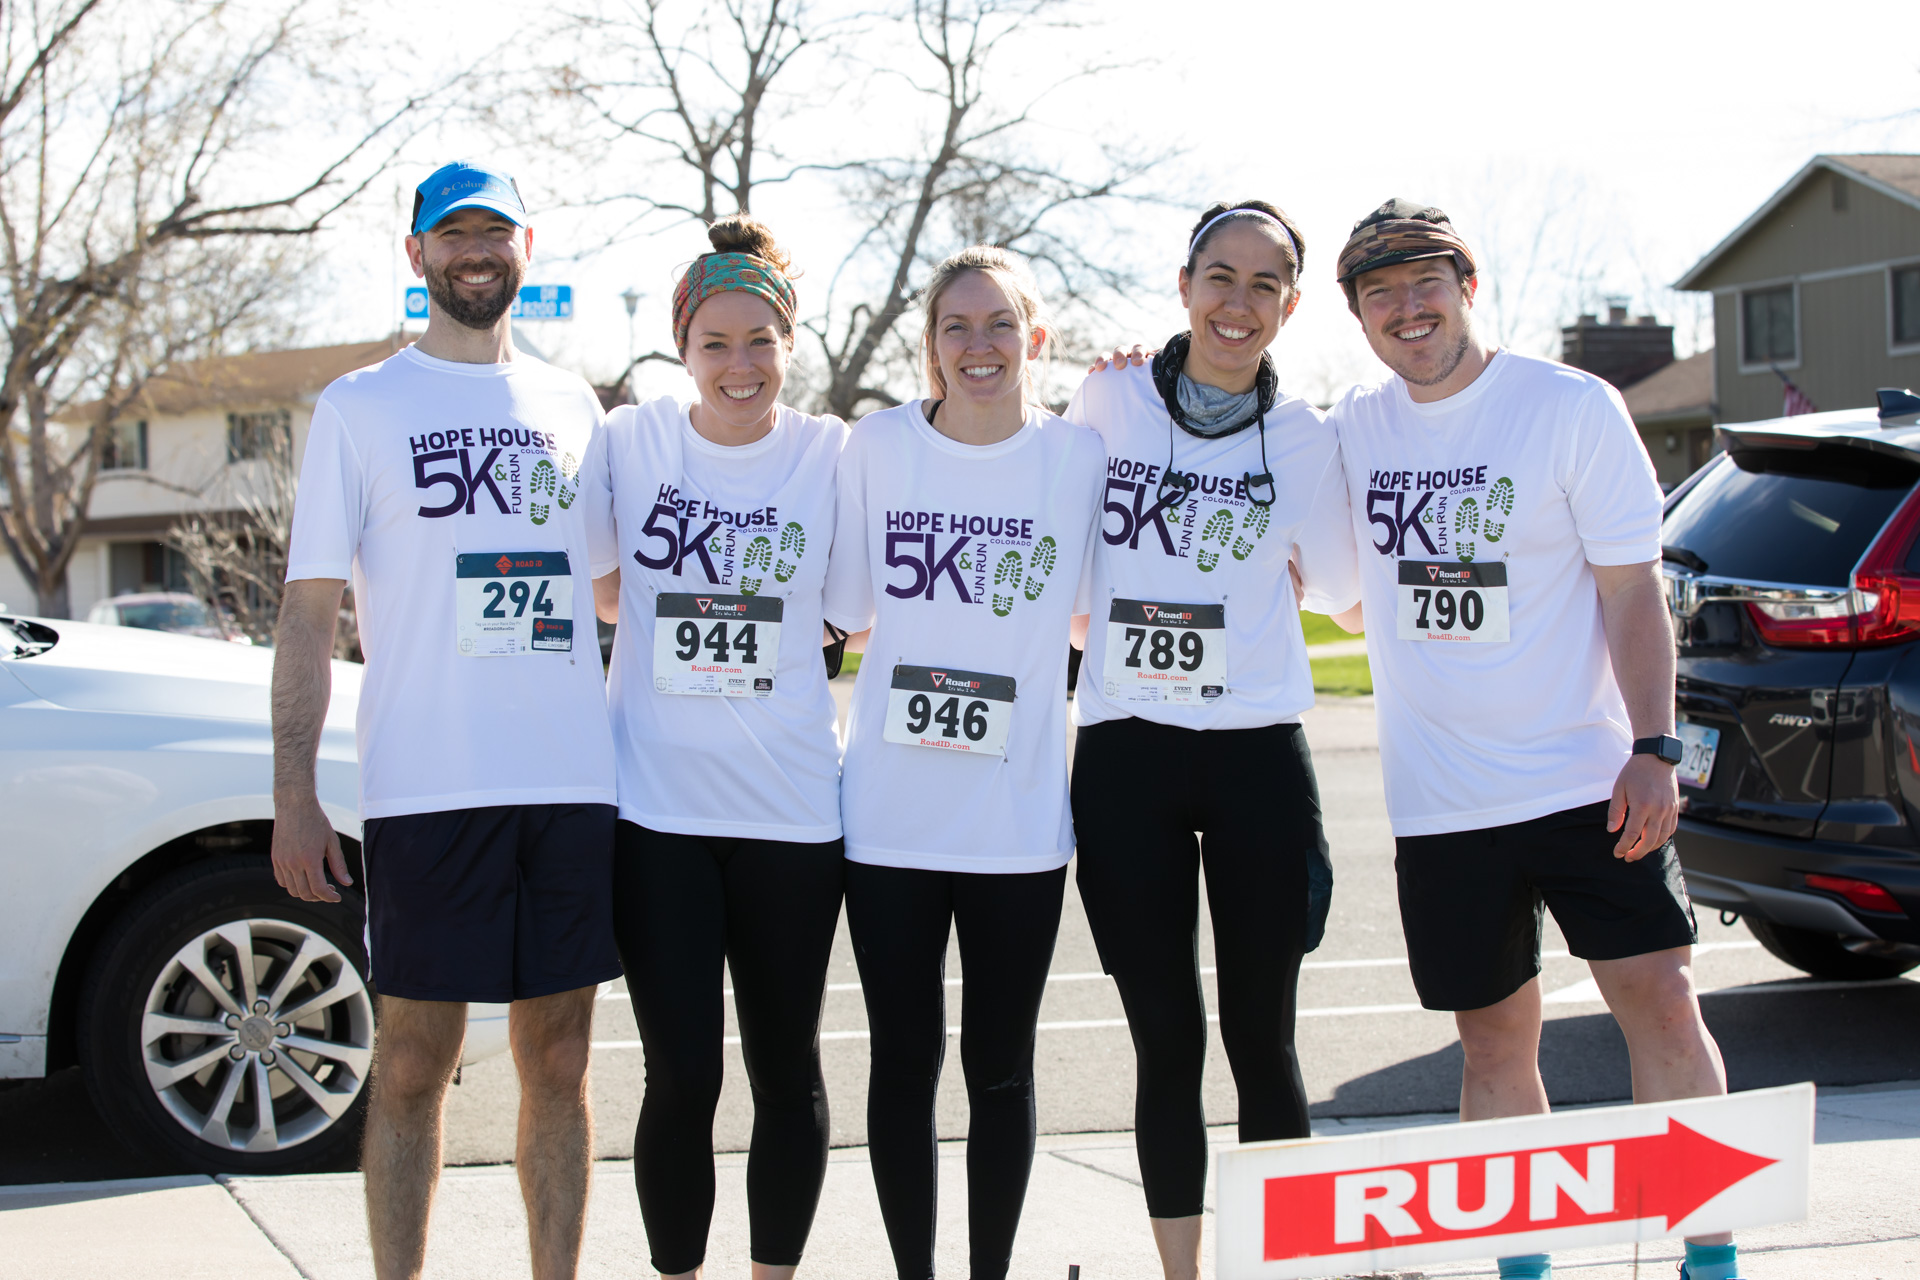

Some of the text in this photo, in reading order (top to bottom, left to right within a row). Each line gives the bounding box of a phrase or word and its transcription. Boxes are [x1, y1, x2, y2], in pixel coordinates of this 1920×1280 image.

[409, 428, 557, 454] HOPE HOUSE
[520, 448, 558, 456] COLORADO
[1107, 456, 1160, 484] HOPE
[1370, 465, 1488, 490] HOPE HOUSE
[413, 448, 522, 518] 5K & FUN RUN
[1450, 486, 1486, 495] COLORADO
[703, 500, 778, 528] HOUSE
[1202, 496, 1246, 507] COLORADO
[886, 511, 1034, 539] HOPE HOUSE
[1102, 478, 1198, 558] 5K & FUN RUN
[1366, 490, 1448, 556] 5K & FUN RUN
[634, 503, 736, 586] 5K & FUN RUN
[990, 538, 1032, 546] COLORADO
[516, 560, 534, 568] ROAD
[885, 532, 987, 604] 5K & FUN RUN
[1439, 570, 1470, 578] RoadID
[483, 580, 554, 618] 294
[712, 603, 747, 612] RoadID
[1414, 588, 1484, 631] 790
[1158, 611, 1192, 620] RoadID
[676, 620, 758, 664] 944
[1125, 627, 1204, 672] 789
[1427, 633, 1471, 641] RoadID.com
[691, 665, 742, 673] RoadID.com
[1137, 672, 1188, 681] RoadID.com
[945, 678, 980, 688] RoadID
[906, 694, 989, 741] 946
[1768, 713, 1812, 727] AWD
[920, 738, 970, 750] RoadID.com
[1334, 1144, 1616, 1246] RUN
